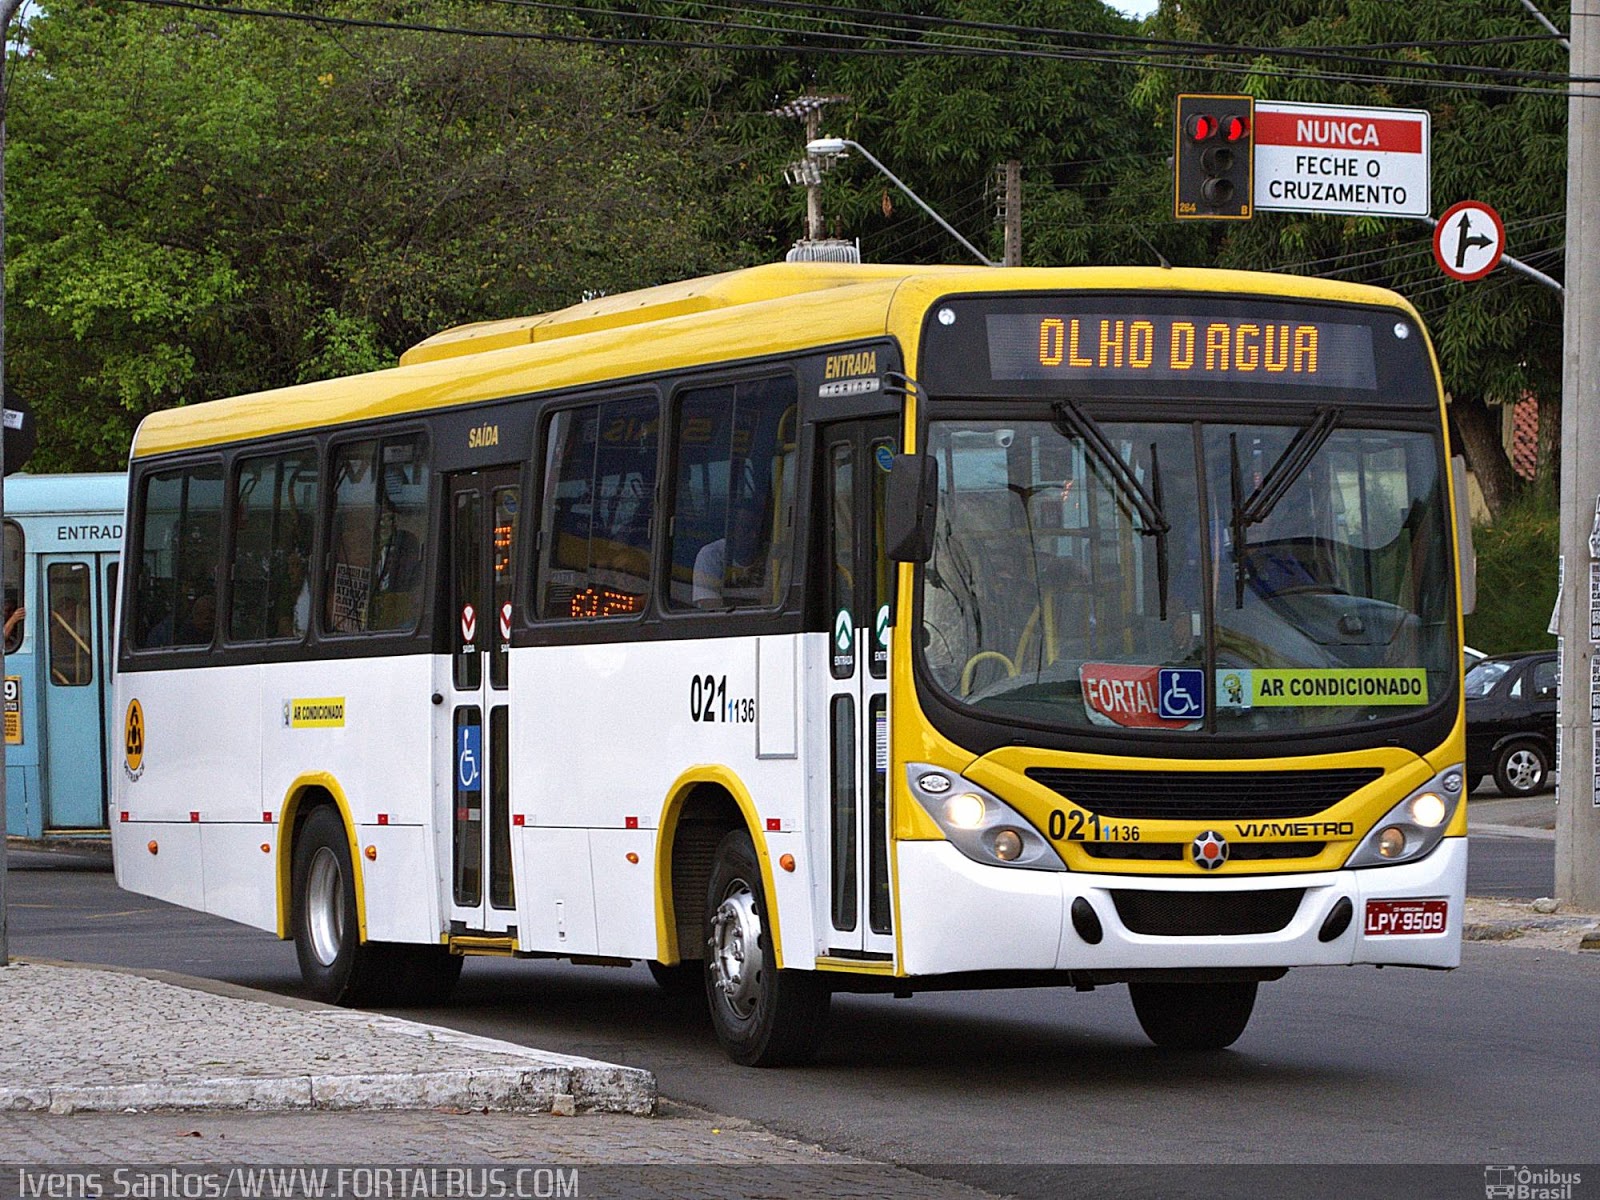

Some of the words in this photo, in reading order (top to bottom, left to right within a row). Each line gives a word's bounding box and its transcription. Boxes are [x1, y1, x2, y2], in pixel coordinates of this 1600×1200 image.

[1296, 119, 1380, 147] NUNCA
[1296, 156, 1358, 177] FECHE
[1367, 159, 1381, 178] O
[1269, 180, 1407, 205] CRUZAMENTO
[1039, 318, 1154, 369] OLHO
[1170, 322, 1196, 370] D
[1205, 323, 1319, 373] AGUA
[825, 351, 877, 379] ENTRADA
[469, 422, 499, 449] SAÍDA
[1259, 678, 1284, 697] AR
[1290, 676, 1423, 697] CONDICIONADO
[294, 706, 302, 720] AR
[303, 704, 343, 720] CONDICIONADO
[1235, 821, 1354, 838] VIAMETRO
